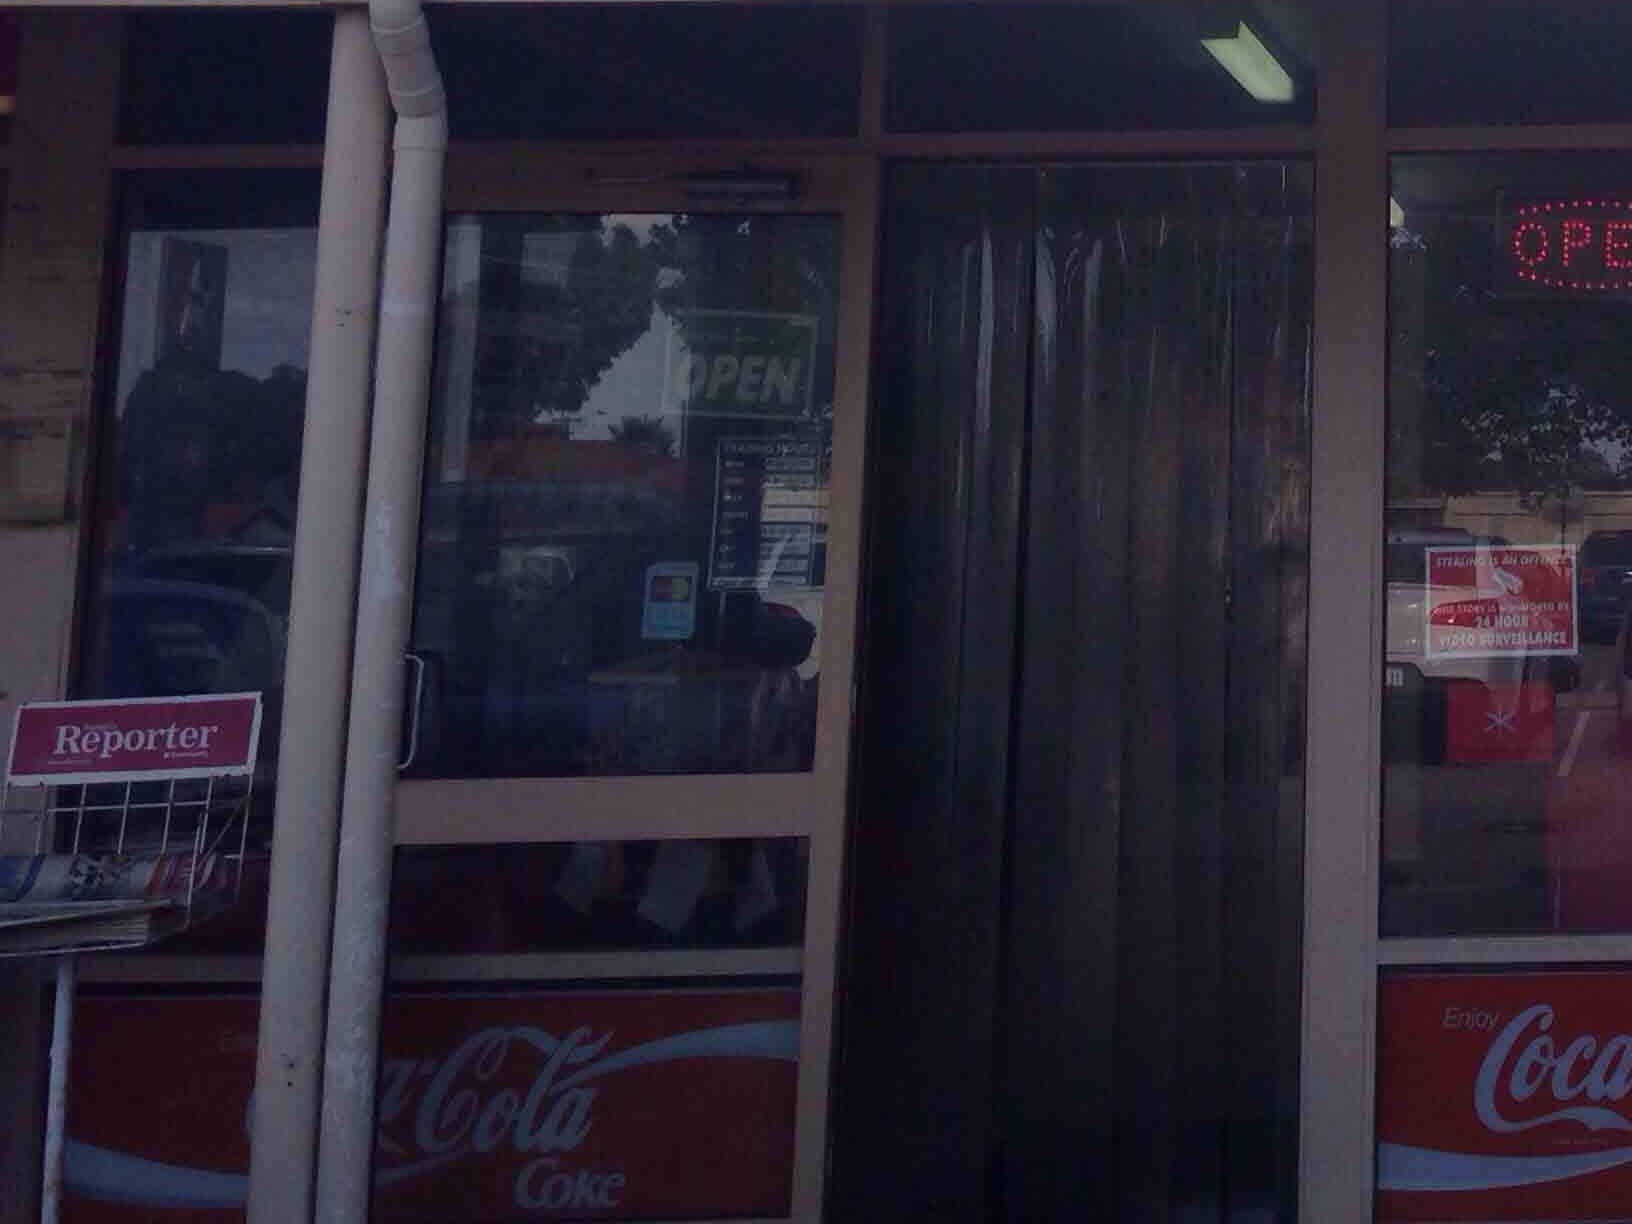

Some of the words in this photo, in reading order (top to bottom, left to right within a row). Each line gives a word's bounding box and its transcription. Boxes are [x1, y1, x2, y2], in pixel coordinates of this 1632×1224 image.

[680, 352, 802, 405] OPEN
[1495, 616, 1530, 629] HOUR
[1439, 633, 1476, 648] VIDEO
[1479, 631, 1568, 648] SURVEILLANCE
[52, 721, 218, 758] Reporter
[1441, 1007, 1499, 1034] Enjoy
[516, 1162, 626, 1207] Coke
